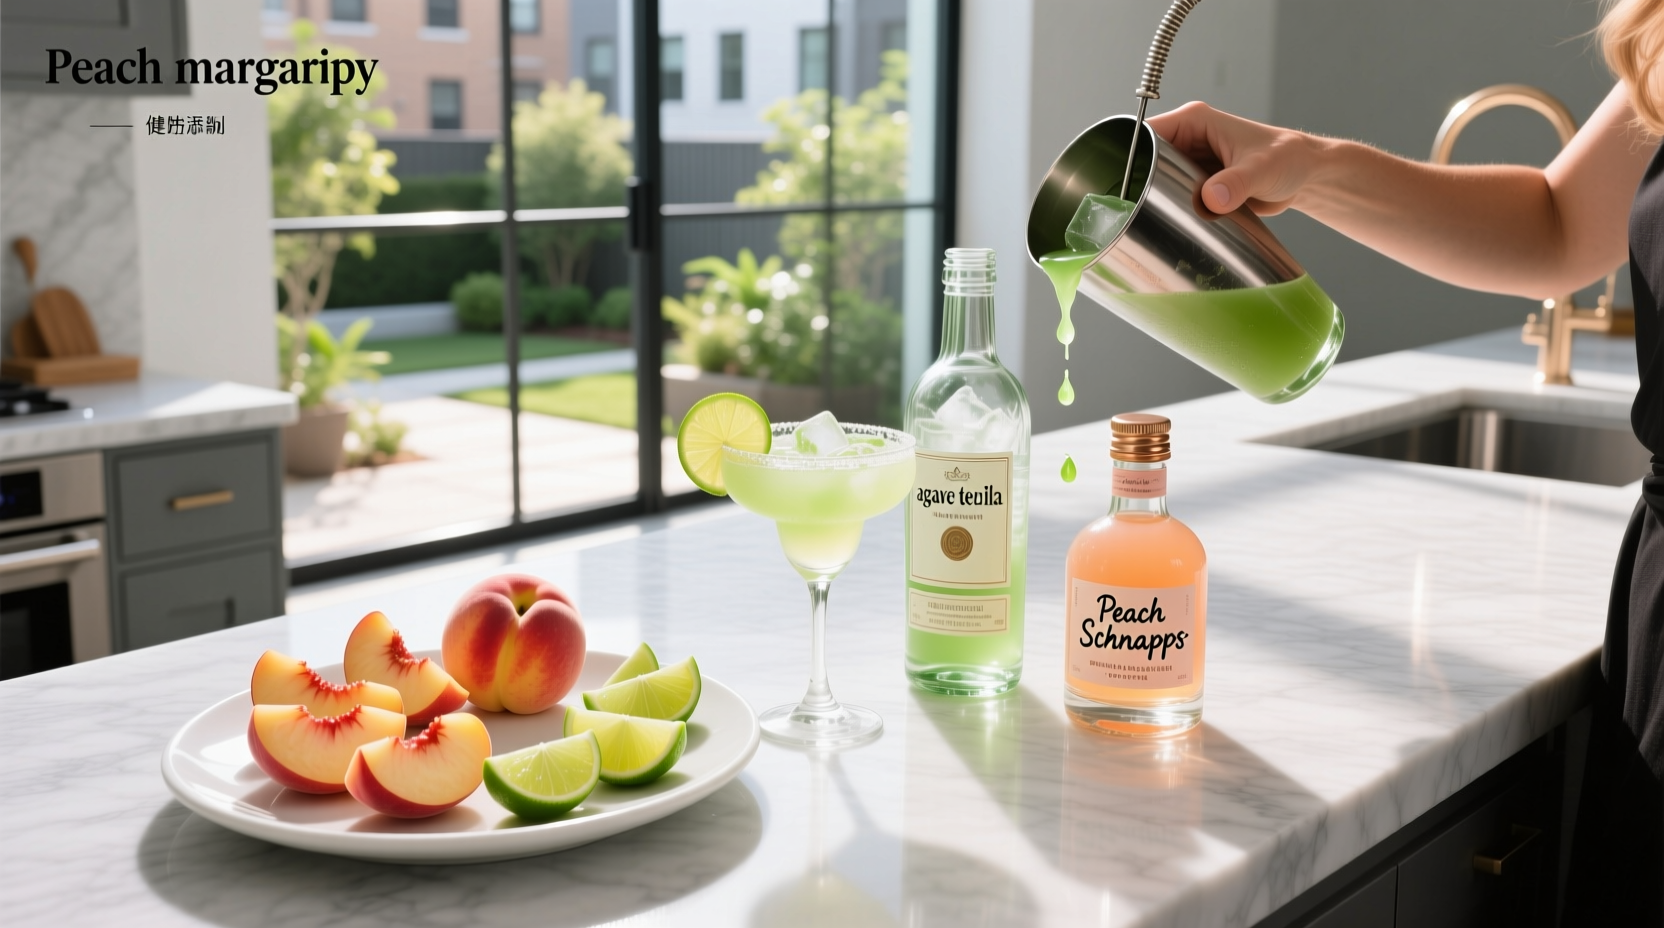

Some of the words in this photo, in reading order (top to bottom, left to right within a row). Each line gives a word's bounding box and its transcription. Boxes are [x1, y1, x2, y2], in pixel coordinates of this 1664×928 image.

[916, 487, 956, 508] agave
[1096, 593, 1166, 624] Peach
[1079, 617, 1189, 661] Schnapps
